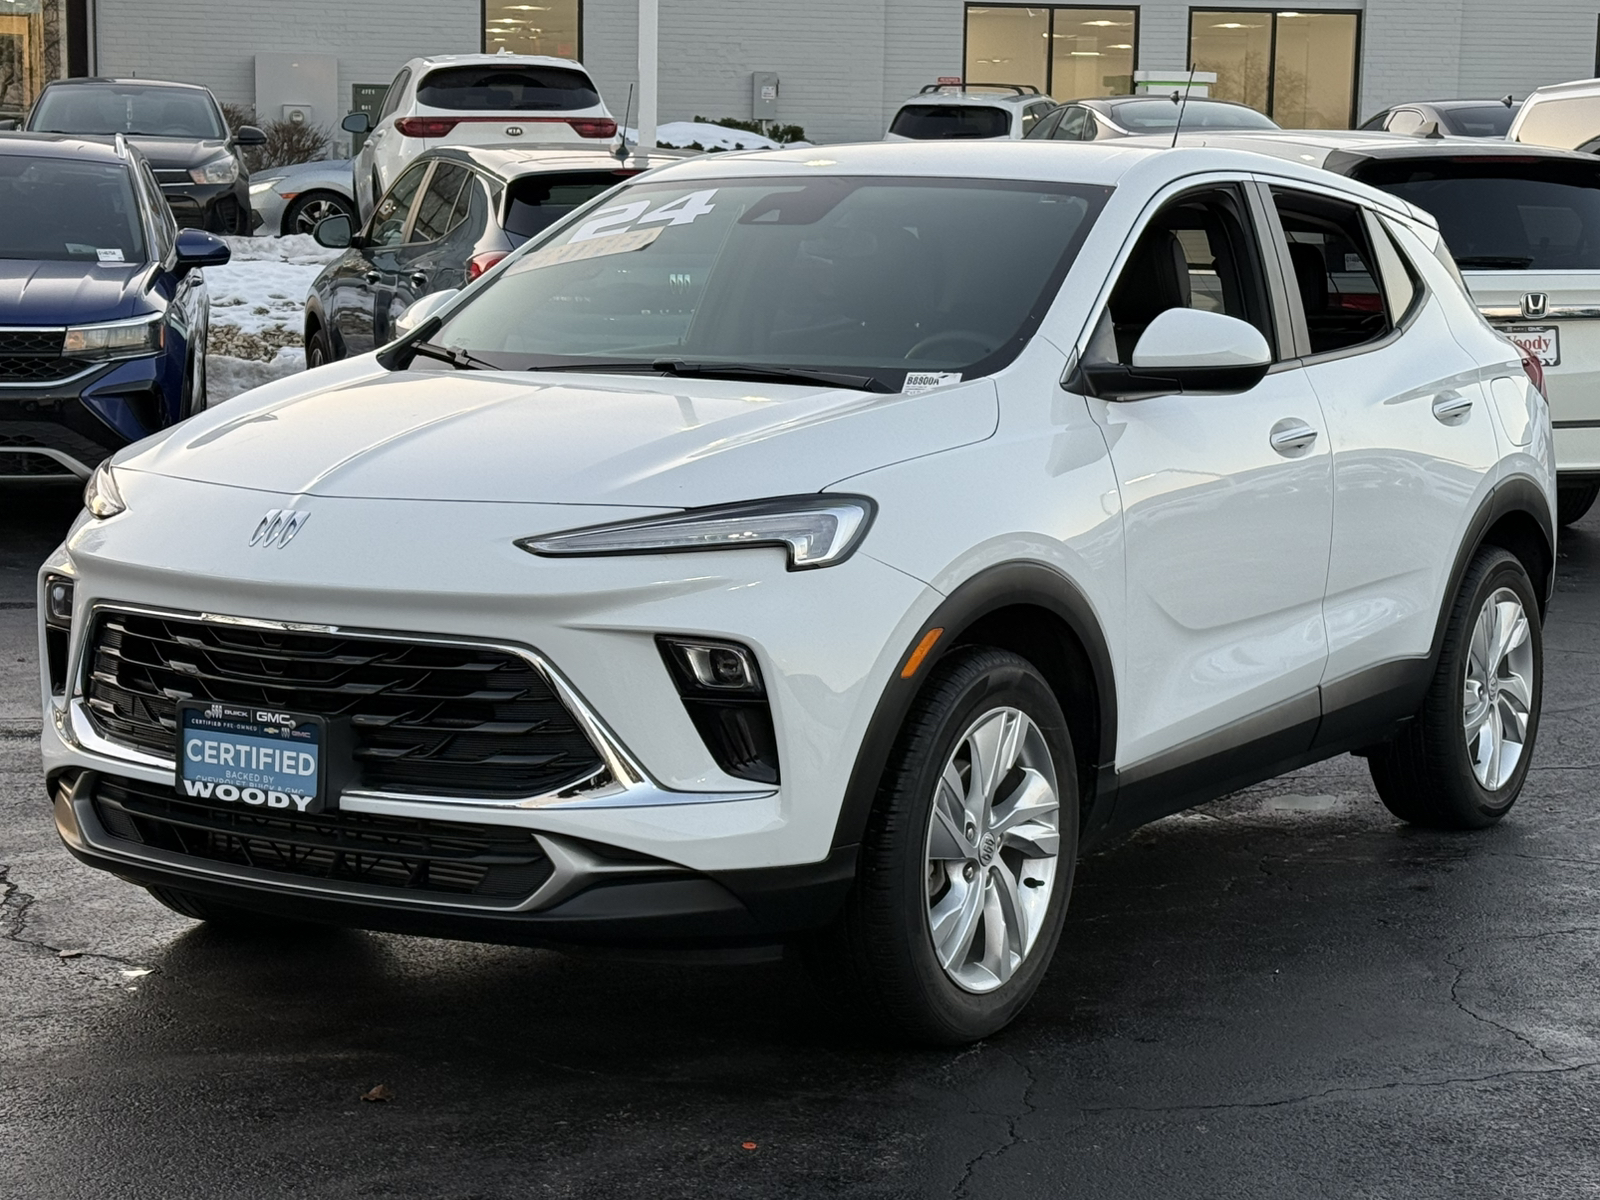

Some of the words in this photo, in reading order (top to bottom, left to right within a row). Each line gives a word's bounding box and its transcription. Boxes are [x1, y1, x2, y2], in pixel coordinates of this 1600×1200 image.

[567, 188, 719, 245] 24
[191, 718, 221, 727] CERTIFIED
[223, 722, 257, 732] PRE-OWNED
[224, 709, 249, 717] BUICK
[256, 711, 290, 725] GMC
[186, 738, 316, 776] CERTIFIED
[225, 770, 260, 782] BACKED
[263, 774, 274, 784] BY
[183, 779, 313, 812] WOODY
